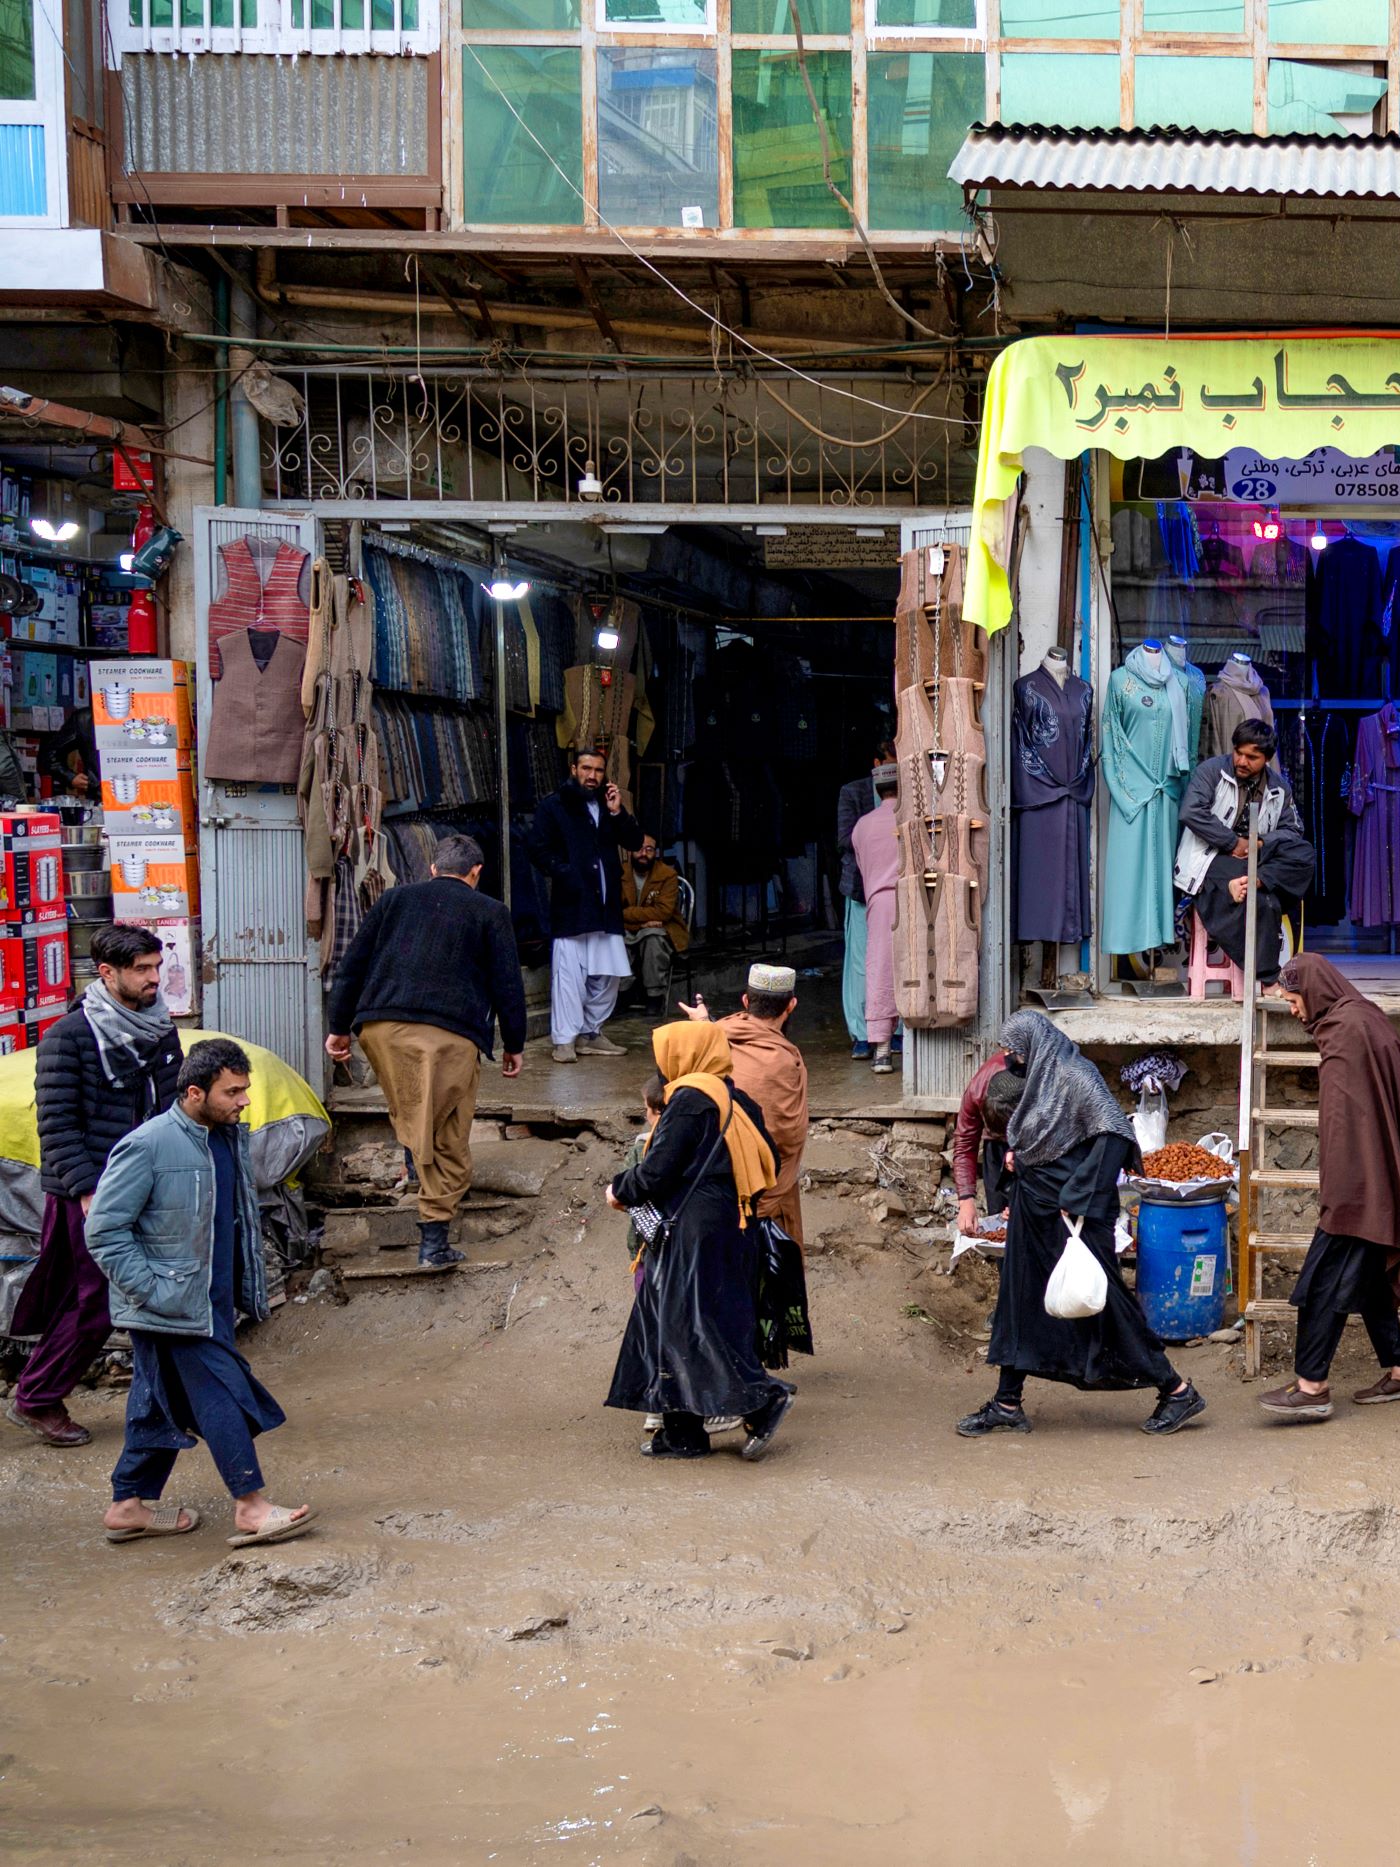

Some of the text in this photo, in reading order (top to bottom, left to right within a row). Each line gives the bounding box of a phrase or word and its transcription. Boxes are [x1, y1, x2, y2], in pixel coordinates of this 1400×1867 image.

[1241, 460, 1279, 478] وطنی
[1241, 480, 1269, 500] 28
[129, 667, 163, 675] COOKWARE
[106, 756, 133, 764] STEAMER
